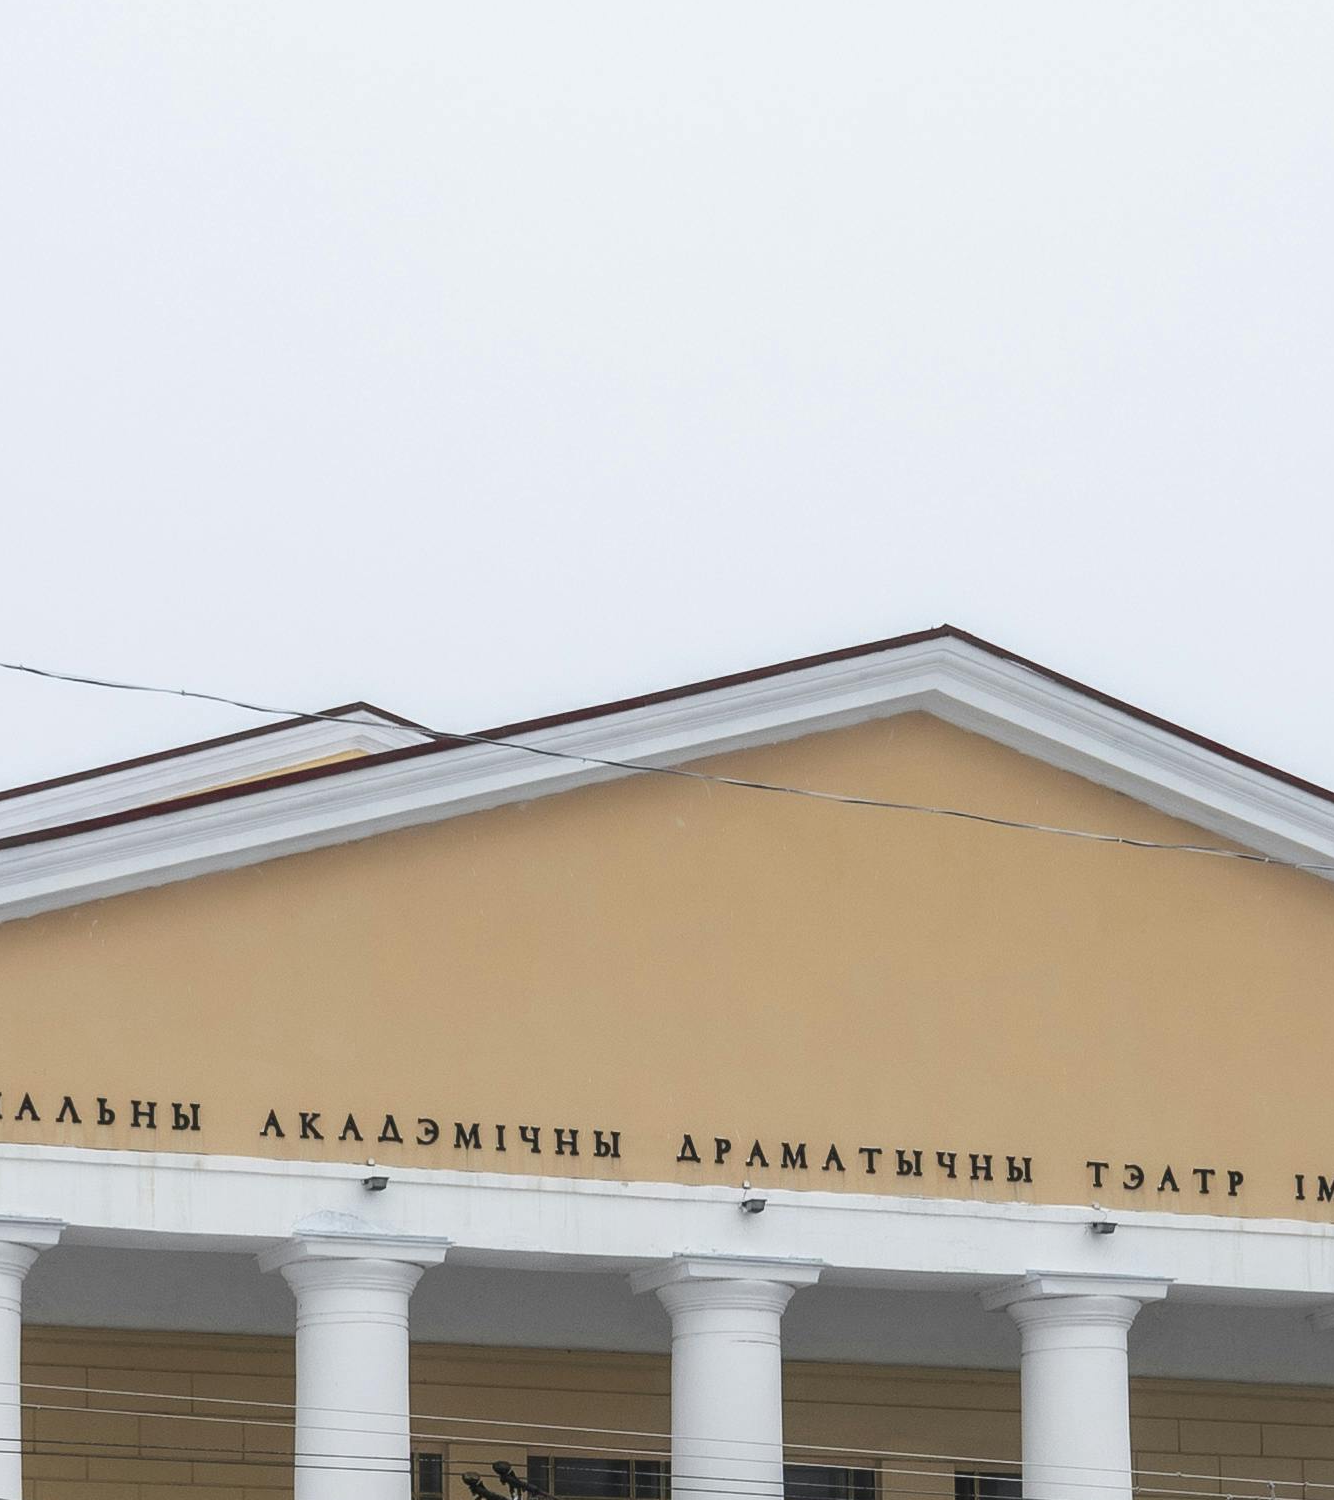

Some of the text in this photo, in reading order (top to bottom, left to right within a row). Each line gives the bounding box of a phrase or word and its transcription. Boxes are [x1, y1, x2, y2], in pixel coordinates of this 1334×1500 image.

[259, 1108, 621, 1157] АКАДЭМІЧНЫ
[676, 1133, 1033, 1183] ДРАМАТЫЧНЫ
[1086, 1160, 1244, 1196] ТЭАТР
